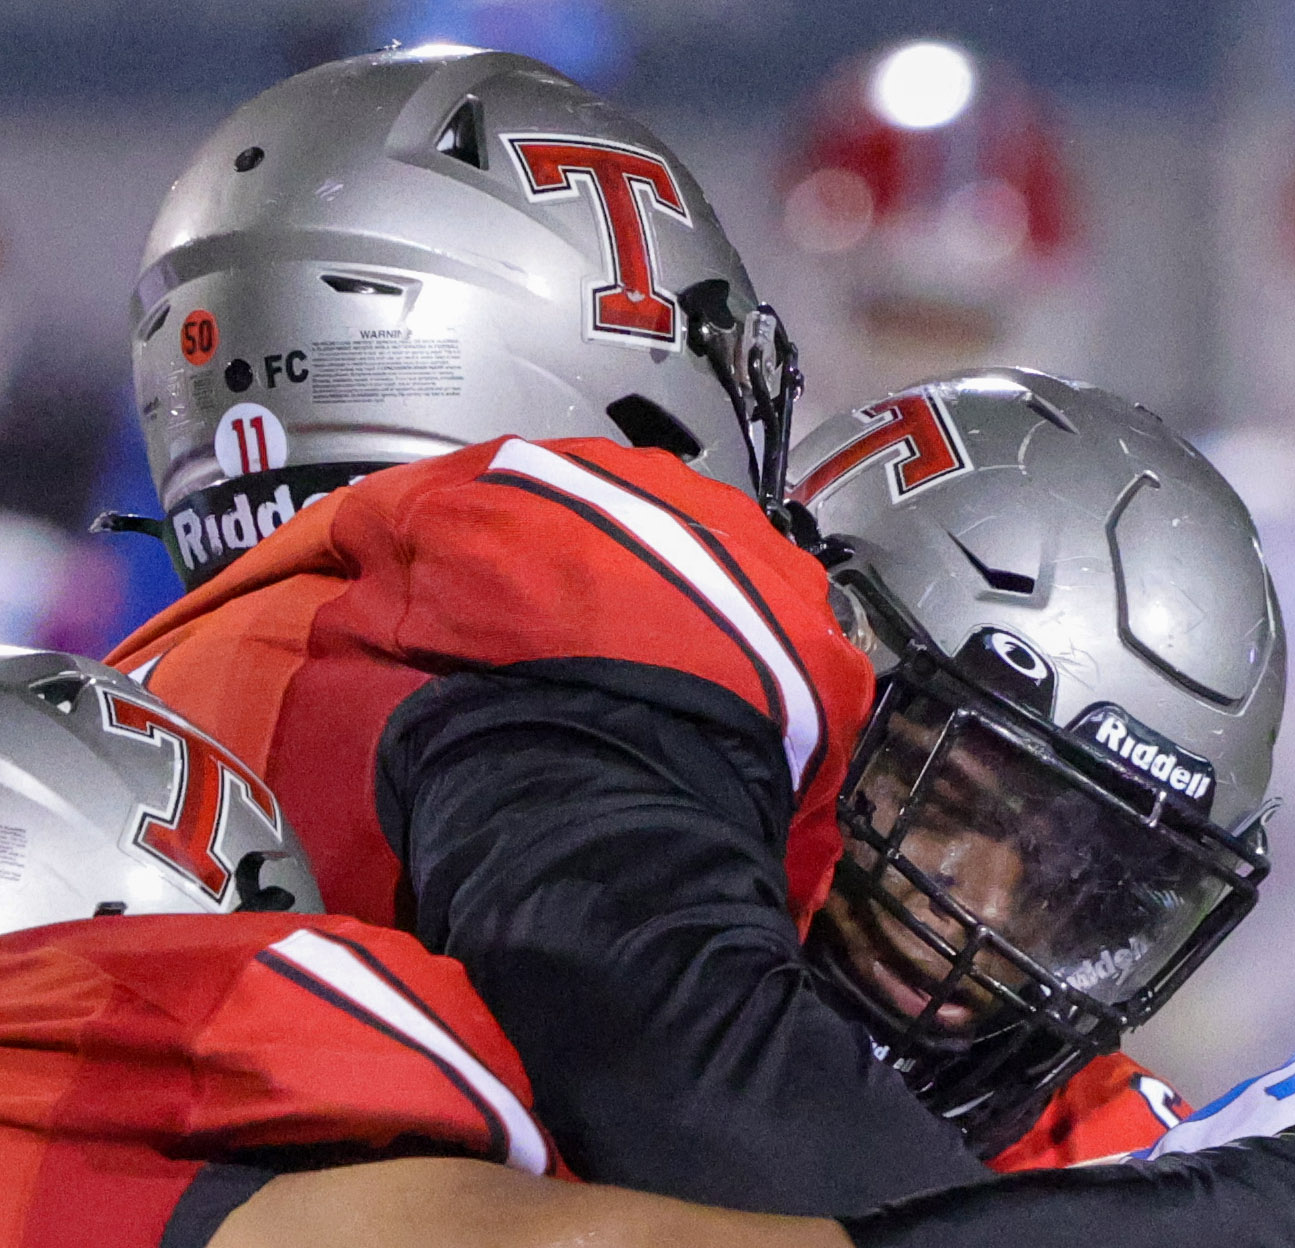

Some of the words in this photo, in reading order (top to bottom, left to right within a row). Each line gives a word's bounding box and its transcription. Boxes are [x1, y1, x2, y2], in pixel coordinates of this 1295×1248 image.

[500, 133, 694, 352] T
[184, 319, 214, 356] 50
[264, 350, 309, 389] FC
[231, 415, 270, 476] 11
[173, 475, 366, 571] Ridd
[1095, 717, 1211, 800] Riddell
